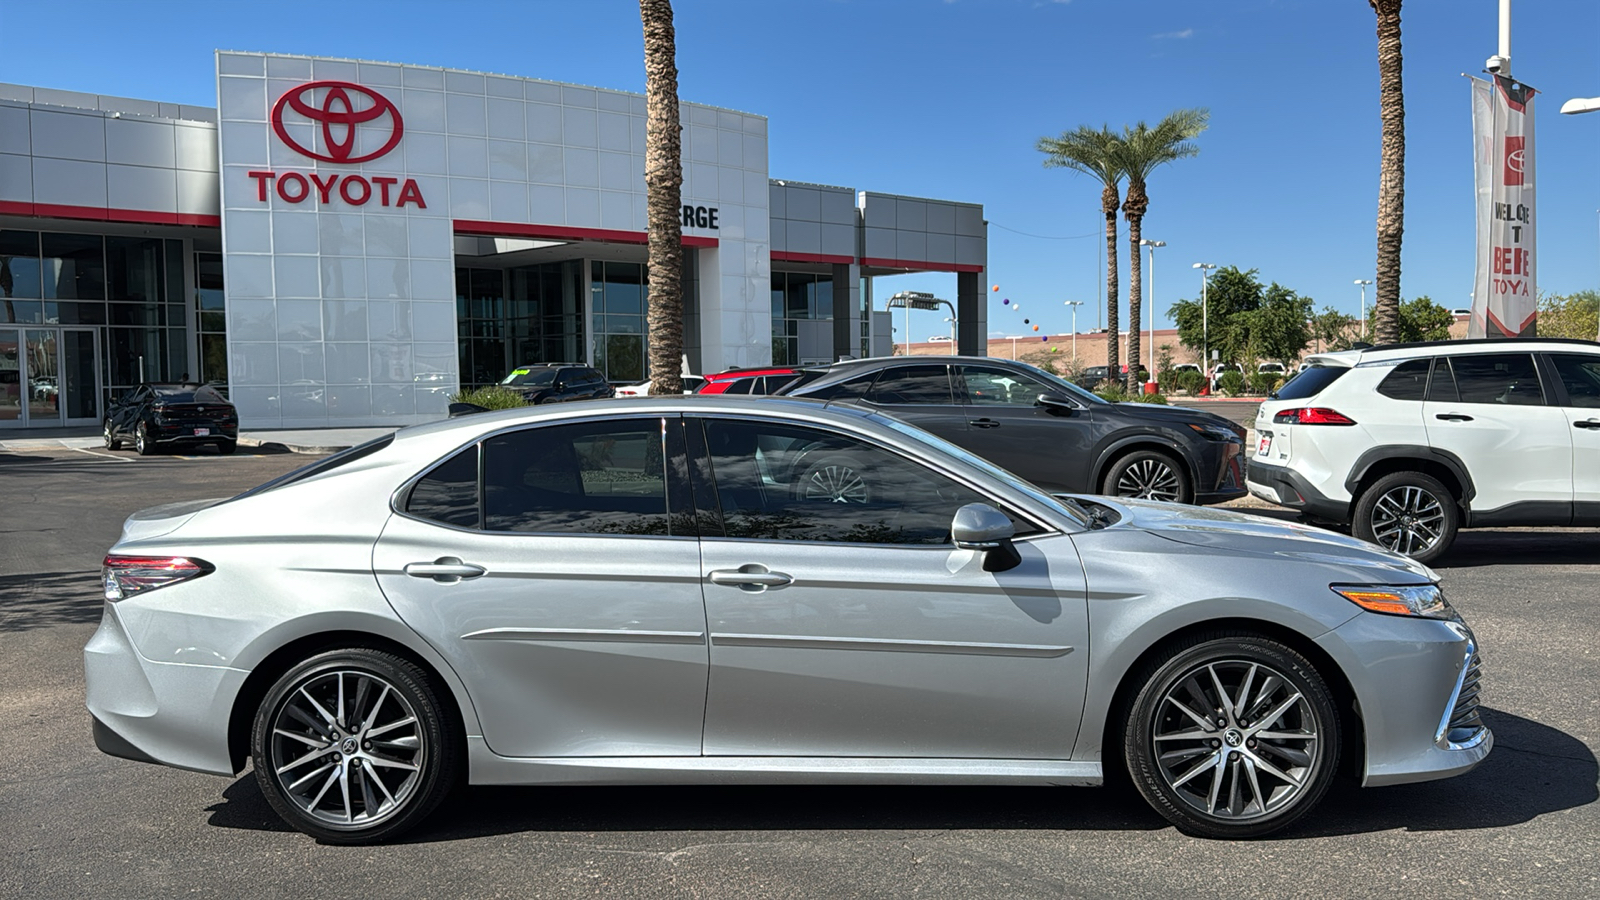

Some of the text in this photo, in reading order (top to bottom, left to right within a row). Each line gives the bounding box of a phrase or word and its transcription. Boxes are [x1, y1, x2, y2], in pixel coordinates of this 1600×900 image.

[248, 171, 427, 209] TOYOTA
[680, 205, 719, 230] RGE
[1495, 202, 1529, 224] WELCE
[1493, 246, 1529, 277] BEE
[1493, 279, 1529, 297] TOYA
[1137, 748, 1187, 819] BRIDGESTONE
